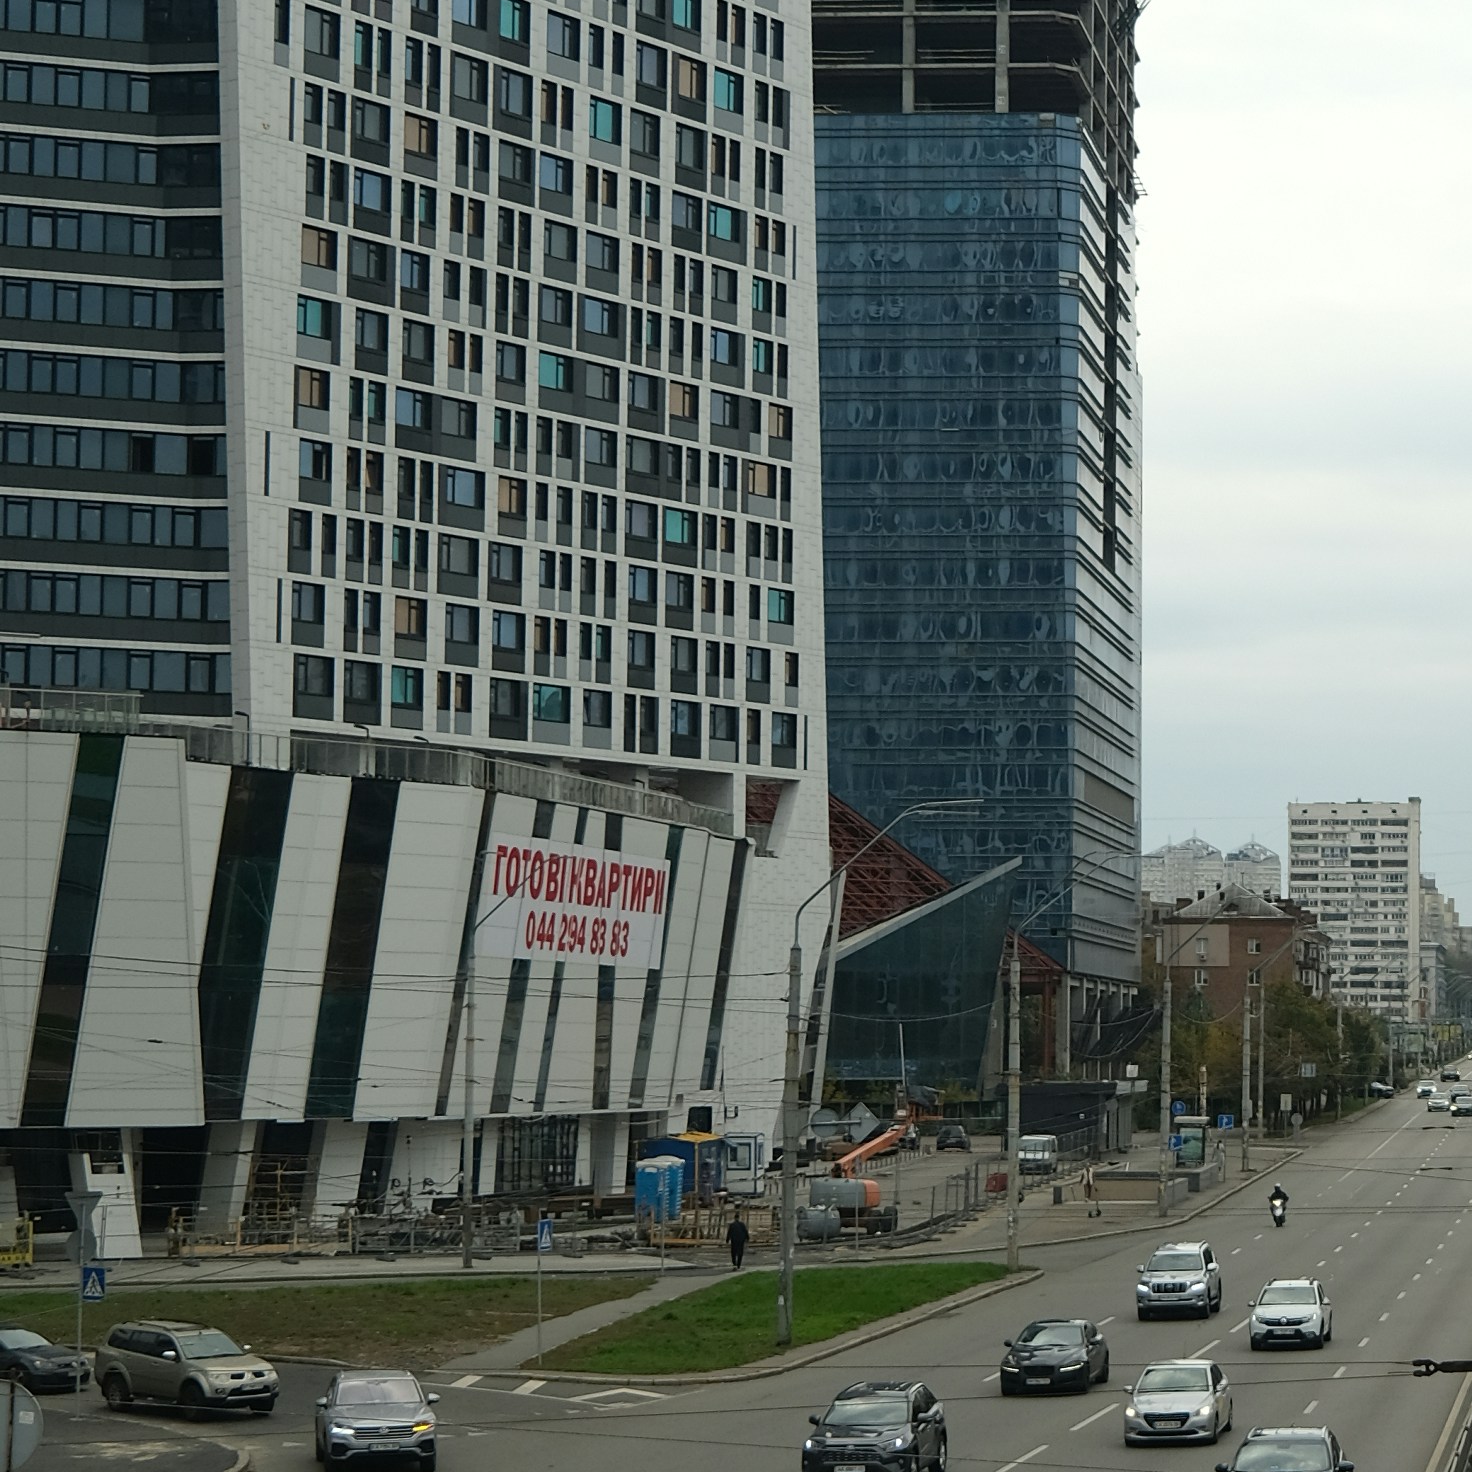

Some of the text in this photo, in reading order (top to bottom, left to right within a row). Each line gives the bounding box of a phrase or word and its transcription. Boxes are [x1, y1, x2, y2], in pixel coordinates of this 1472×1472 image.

[493, 845, 567, 903] ГОТОВІ
[525, 911, 629, 957] 044 294 83 83
